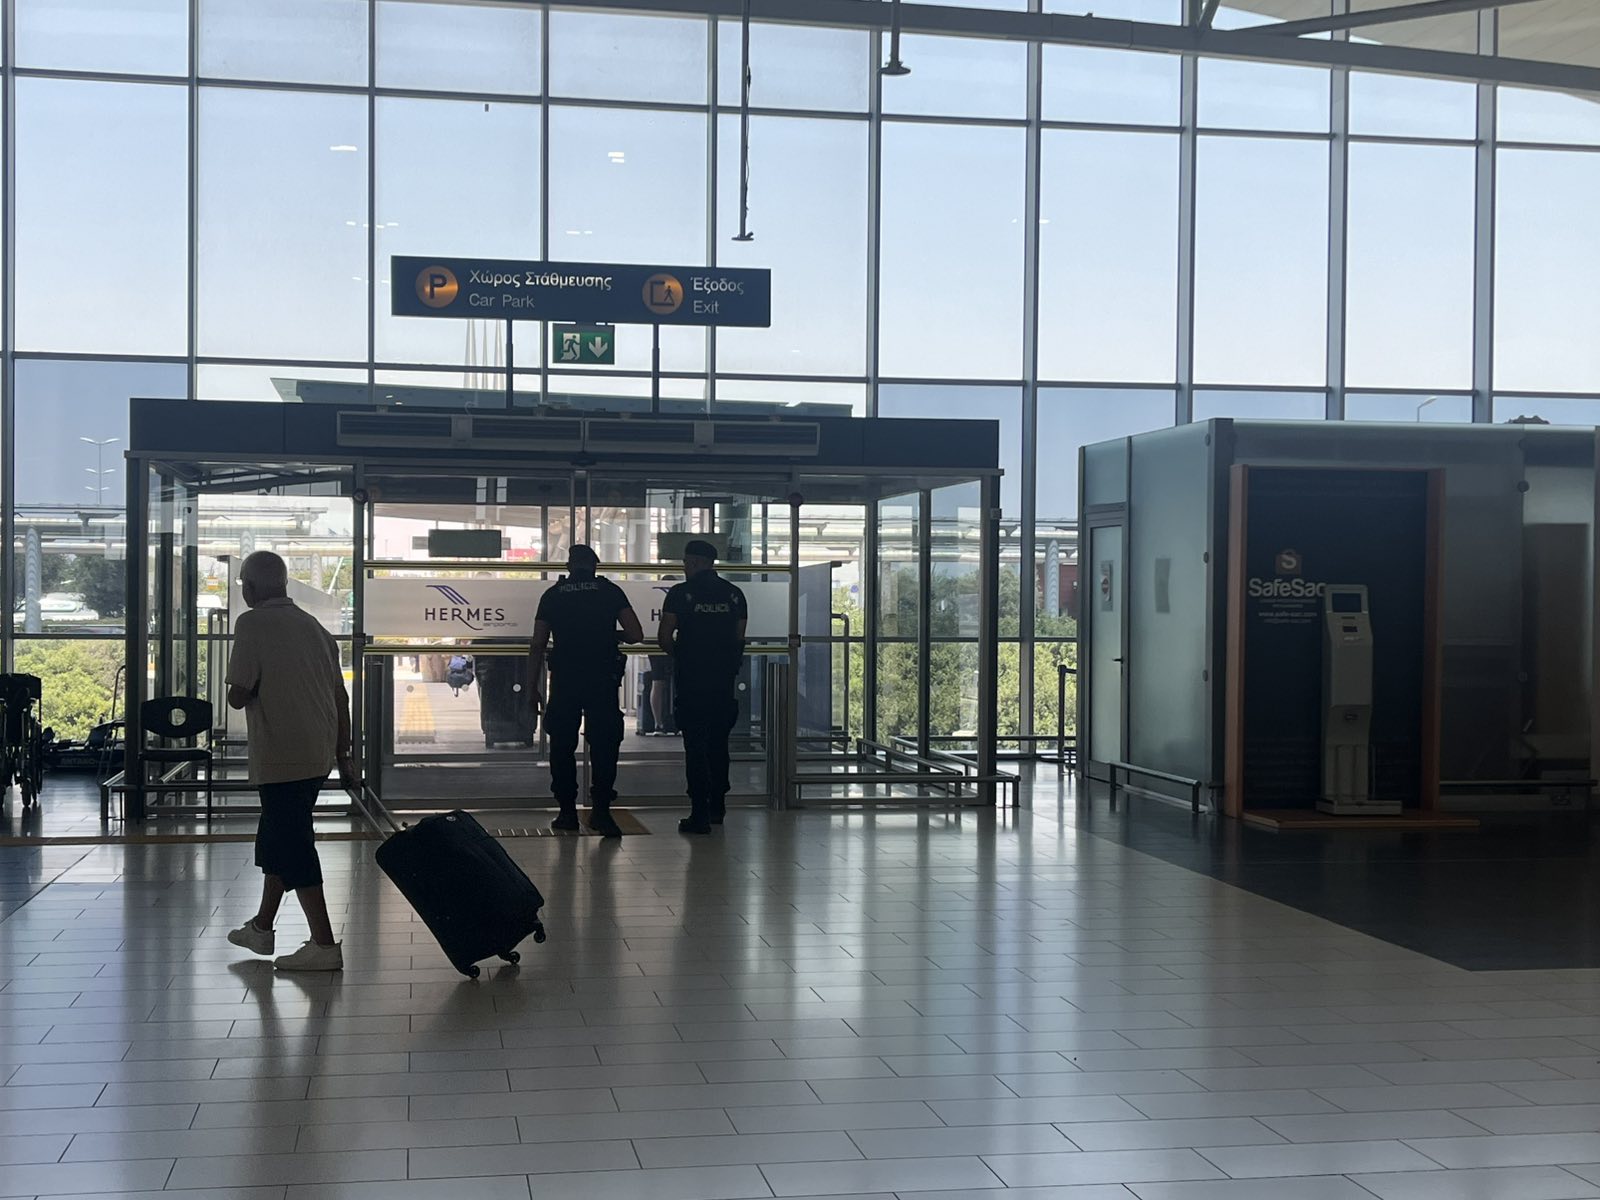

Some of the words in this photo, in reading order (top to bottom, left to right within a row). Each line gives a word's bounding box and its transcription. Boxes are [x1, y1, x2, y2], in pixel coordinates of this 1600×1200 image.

[429, 273, 447, 299] P
[469, 269, 521, 288] Χώρος
[525, 271, 612, 291] Στάθμευσης
[690, 276, 744, 295] Έξοδος
[469, 293, 495, 307] Car
[502, 293, 535, 308] Park
[693, 300, 720, 314] Exit
[425, 607, 505, 629] HERMES
